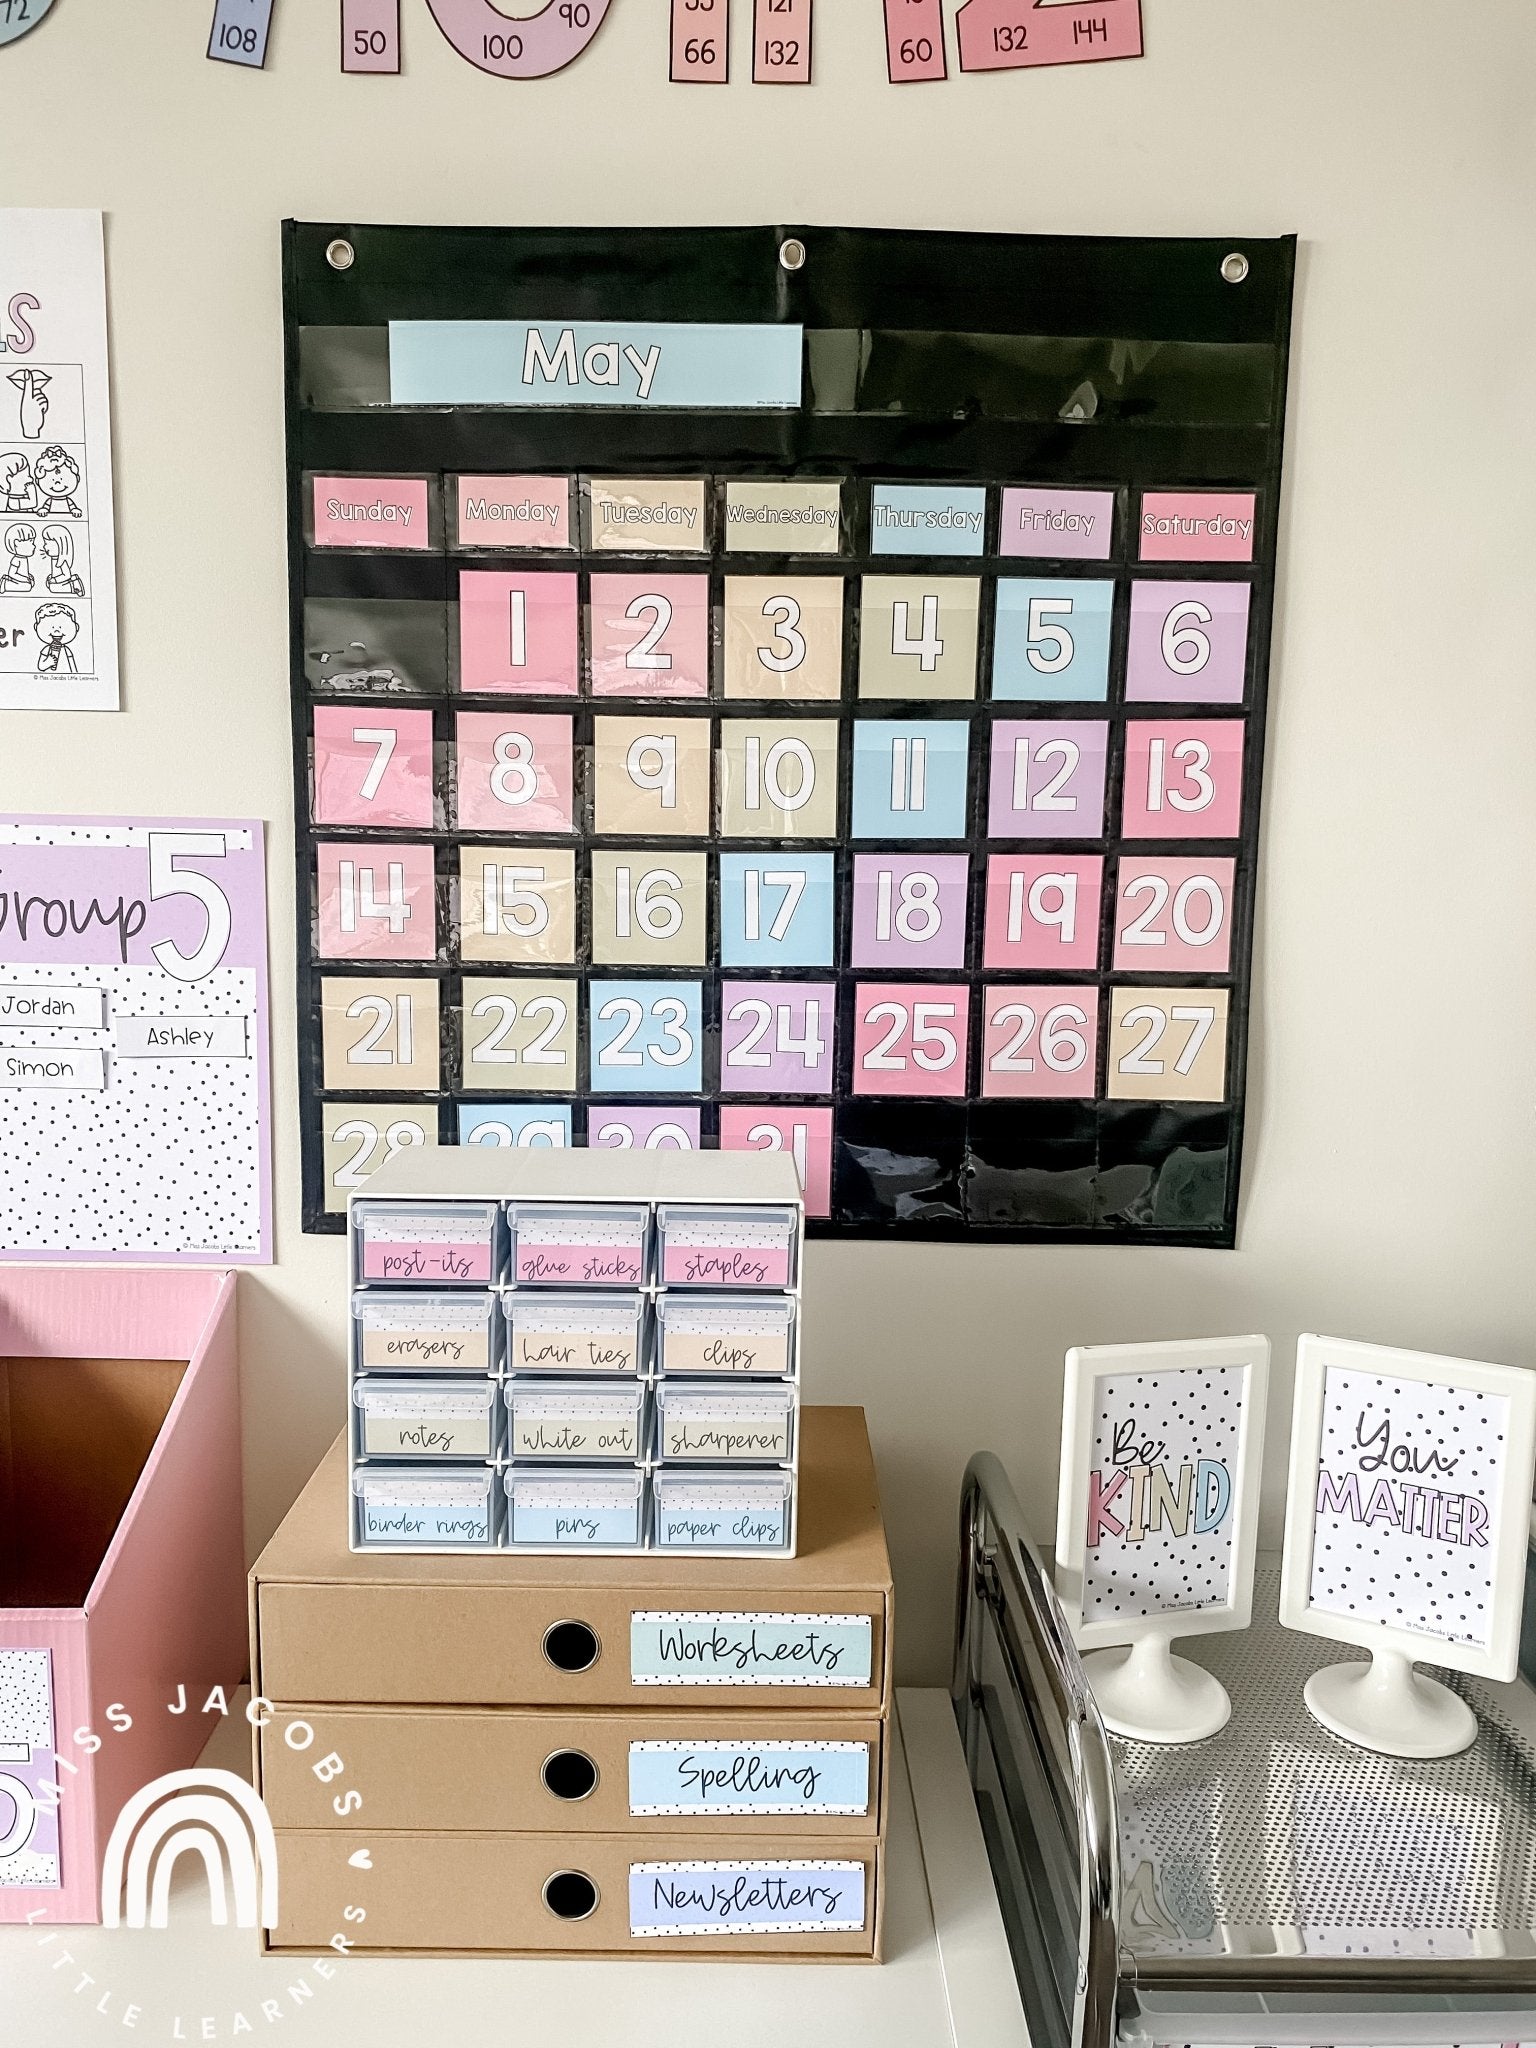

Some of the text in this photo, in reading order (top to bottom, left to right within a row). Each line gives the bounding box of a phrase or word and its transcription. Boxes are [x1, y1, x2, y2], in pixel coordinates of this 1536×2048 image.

[558, 4, 590, 28] 90
[219, 24, 257, 53] 108
[354, 30, 386, 55] 50
[482, 34, 523, 59] 100
[993, 17, 1107, 52] 132 144
[684, 38, 716, 64] 66
[765, 40, 799, 65] 132
[900, 38, 932, 63] 60
[521, 328, 662, 400] May
[326, 498, 1252, 540] Sunday Monday Tuesday Wednesday Thursday Friday Saturday
[509, 590, 1212, 675] 1 2 3 4 5 6
[352, 727, 1215, 812] 7 8 9 10 11 12 13
[148, 832, 232, 982] 5
[339, 860, 1225, 947] 14 15 16 17 18 19 20
[1, 996, 75, 1015] Jordan
[147, 1027, 214, 1049] Ashley
[345, 994, 1216, 1076] 21 22 23 24 25 26 27
[6, 1058, 74, 1077] Simon
[383, 1249, 474, 1277] post-its
[522, 1254, 641, 1281] glue sticks
[685, 1253, 769, 1282] staples
[387, 1338, 464, 1361] erasers
[522, 1338, 631, 1369] hair ties
[703, 1340, 756, 1368] clips
[400, 1425, 455, 1451] notes
[522, 1427, 633, 1452] white out
[671, 1430, 785, 1455] sharpener
[1112, 1418, 1166, 1466] Be
[1356, 1411, 1458, 1473] You
[1087, 1458, 1231, 1548] KIND
[1316, 1469, 1489, 1548] MATTER
[368, 1512, 489, 1538] binder rings
[555, 1516, 600, 1540] pins
[667, 1515, 780, 1542] paper clips
[659, 1627, 845, 1670] Worksheets
[678, 1756, 822, 1799] Spelling
[654, 1876, 843, 1917] Newsletters
